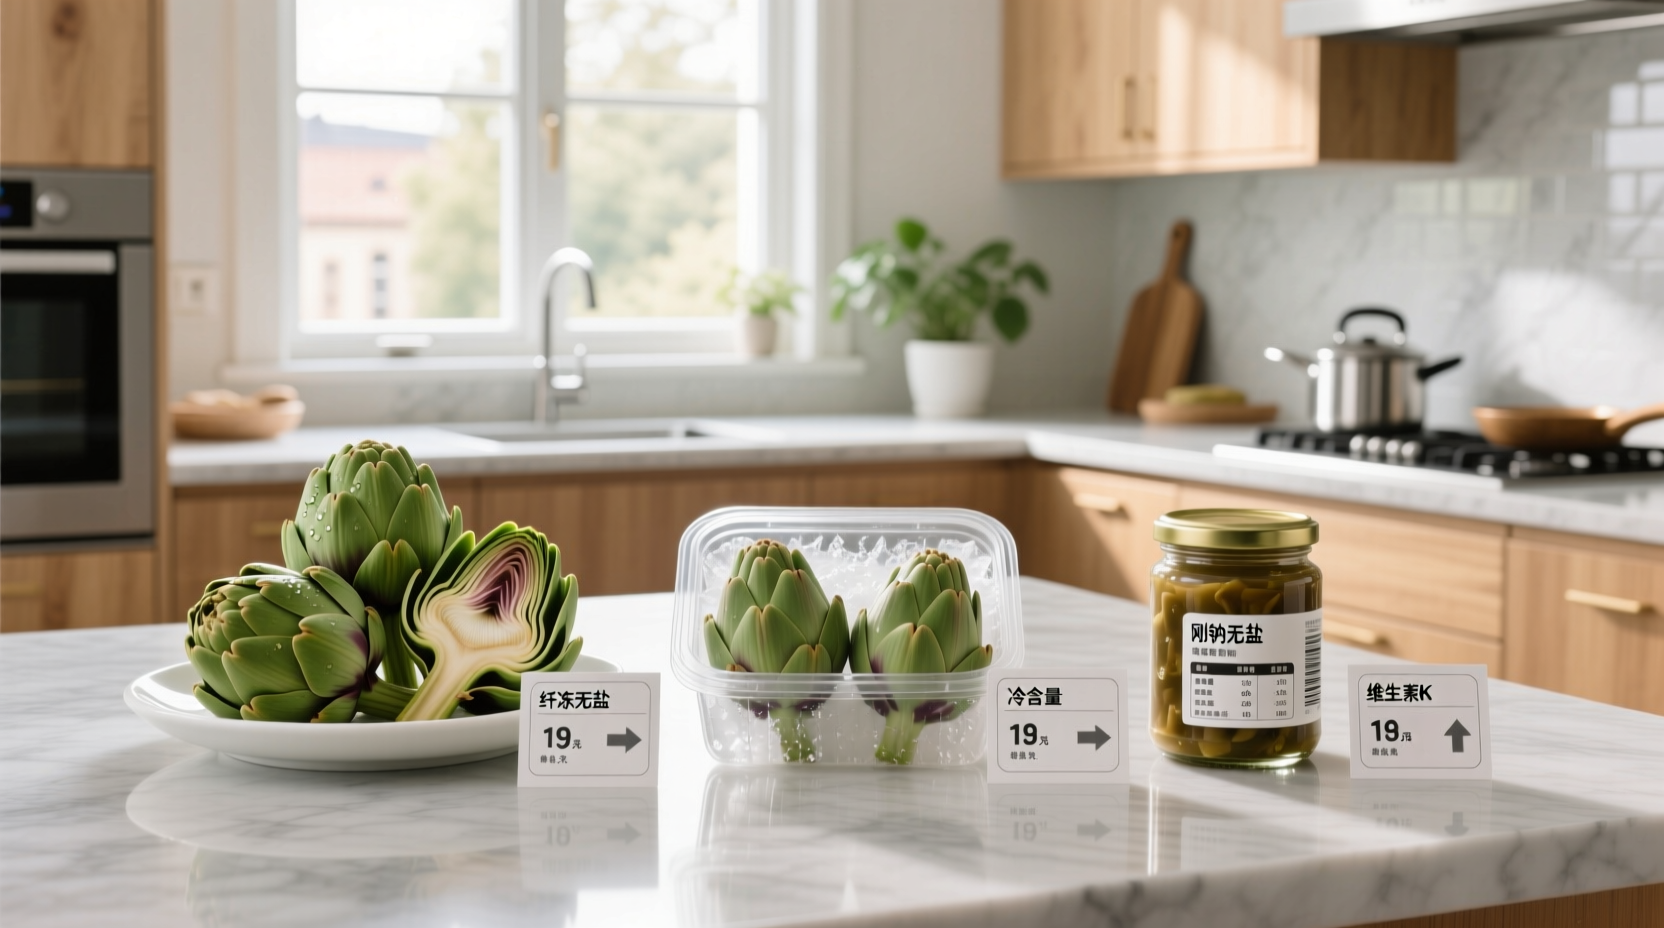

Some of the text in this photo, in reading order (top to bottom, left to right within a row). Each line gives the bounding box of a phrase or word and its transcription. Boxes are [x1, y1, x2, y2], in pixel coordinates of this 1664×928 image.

[1008, 686, 1063, 706] 冷含量
[1366, 682, 1433, 703] 维生素K
